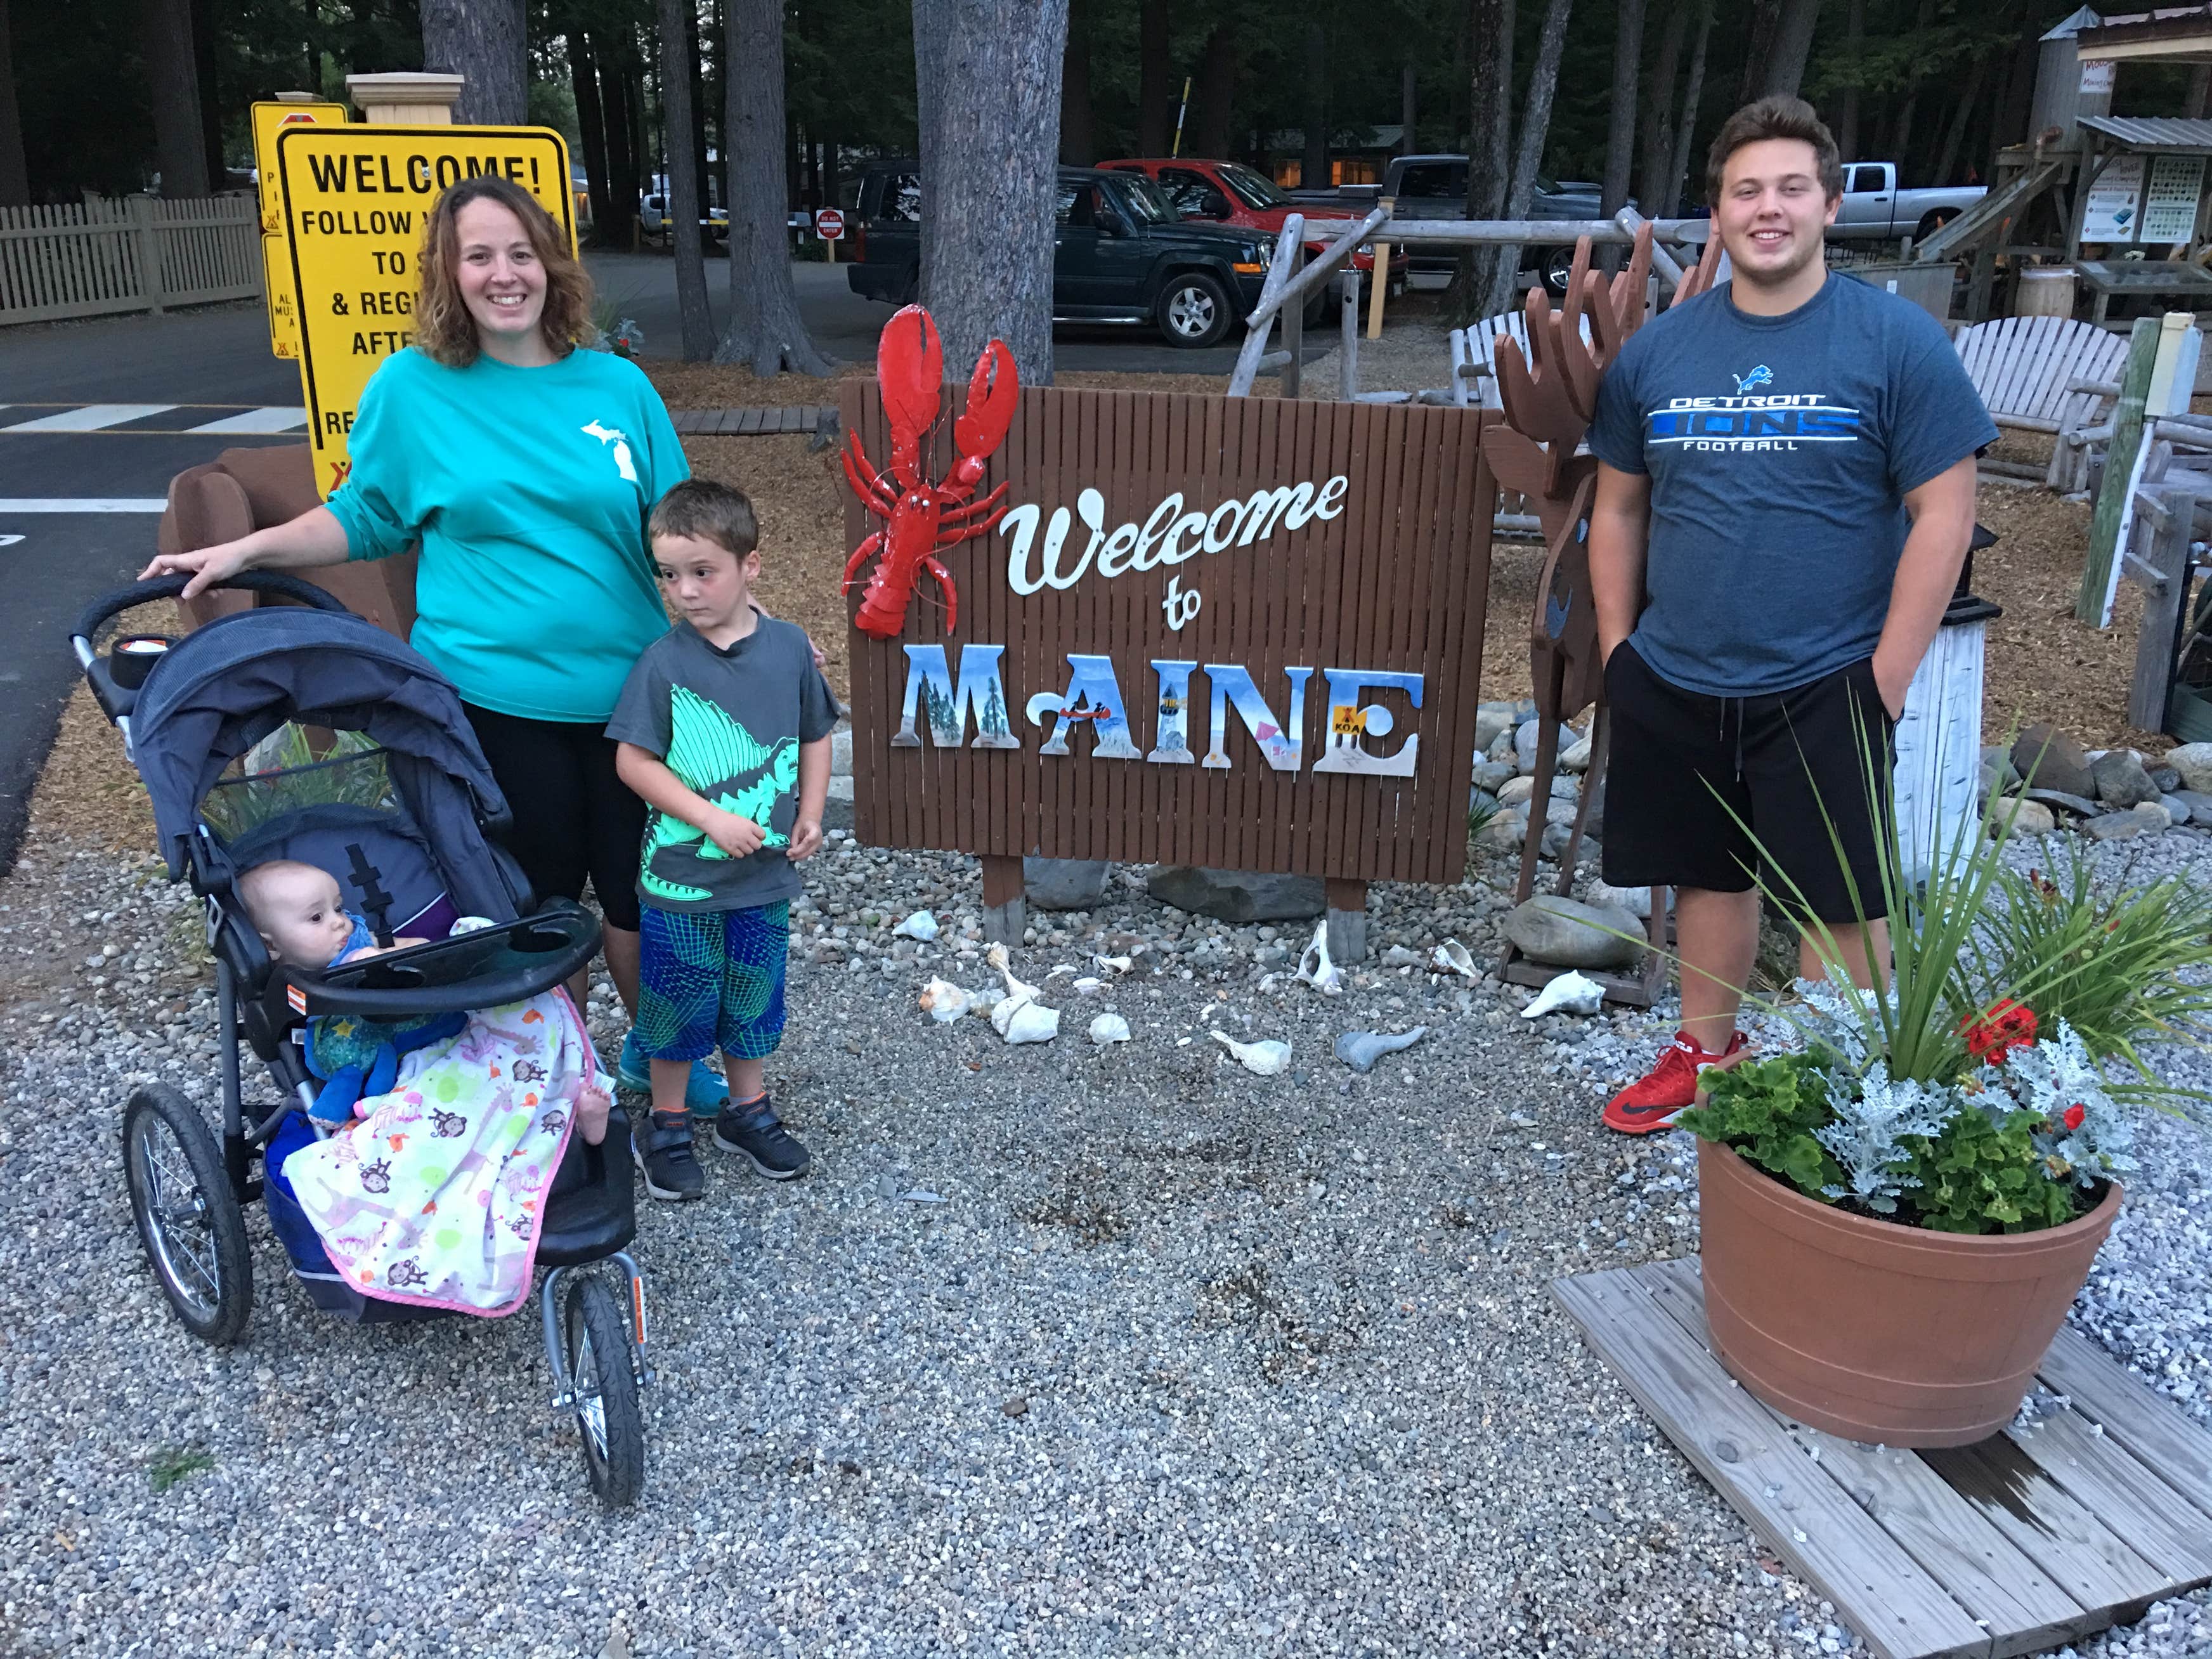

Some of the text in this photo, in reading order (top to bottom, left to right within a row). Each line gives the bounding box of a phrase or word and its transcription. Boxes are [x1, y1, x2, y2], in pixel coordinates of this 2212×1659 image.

[308, 154, 540, 194] WELCOME!
[301, 211, 411, 235] FOLLOW
[372, 251, 406, 275] TO
[332, 292, 349, 315] &
[1669, 394, 1826, 409] DETROIT
[1682, 440, 1799, 452] FOOTBALL
[999, 475, 1349, 596] Welcome
[1162, 575, 1202, 630] to
[890, 643, 1424, 777] MAINE
[1335, 724, 1360, 733] KOA
